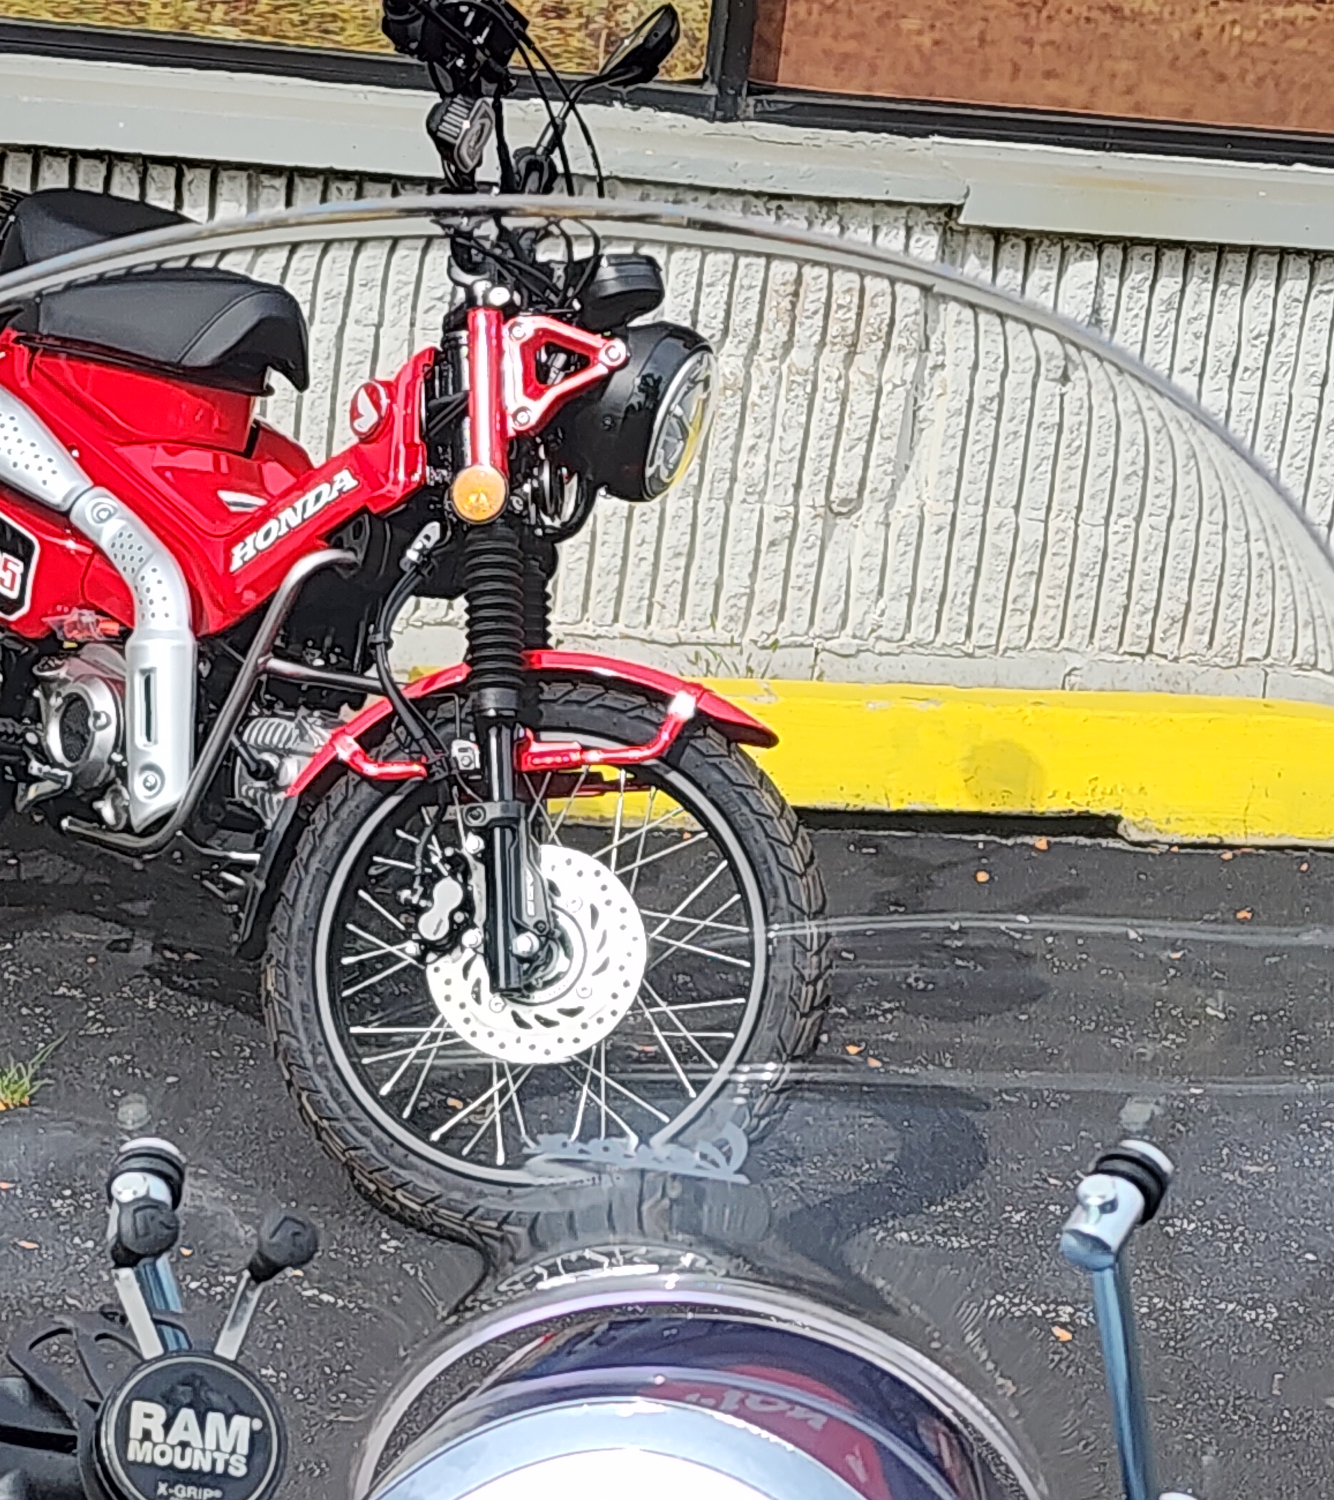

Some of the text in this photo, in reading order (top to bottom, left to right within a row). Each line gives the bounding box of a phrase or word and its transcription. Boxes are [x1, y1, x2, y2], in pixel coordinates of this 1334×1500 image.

[229, 468, 359, 574] HONDA
[129, 1400, 251, 1456] RAM
[127, 1439, 248, 1478] MOUNTS
